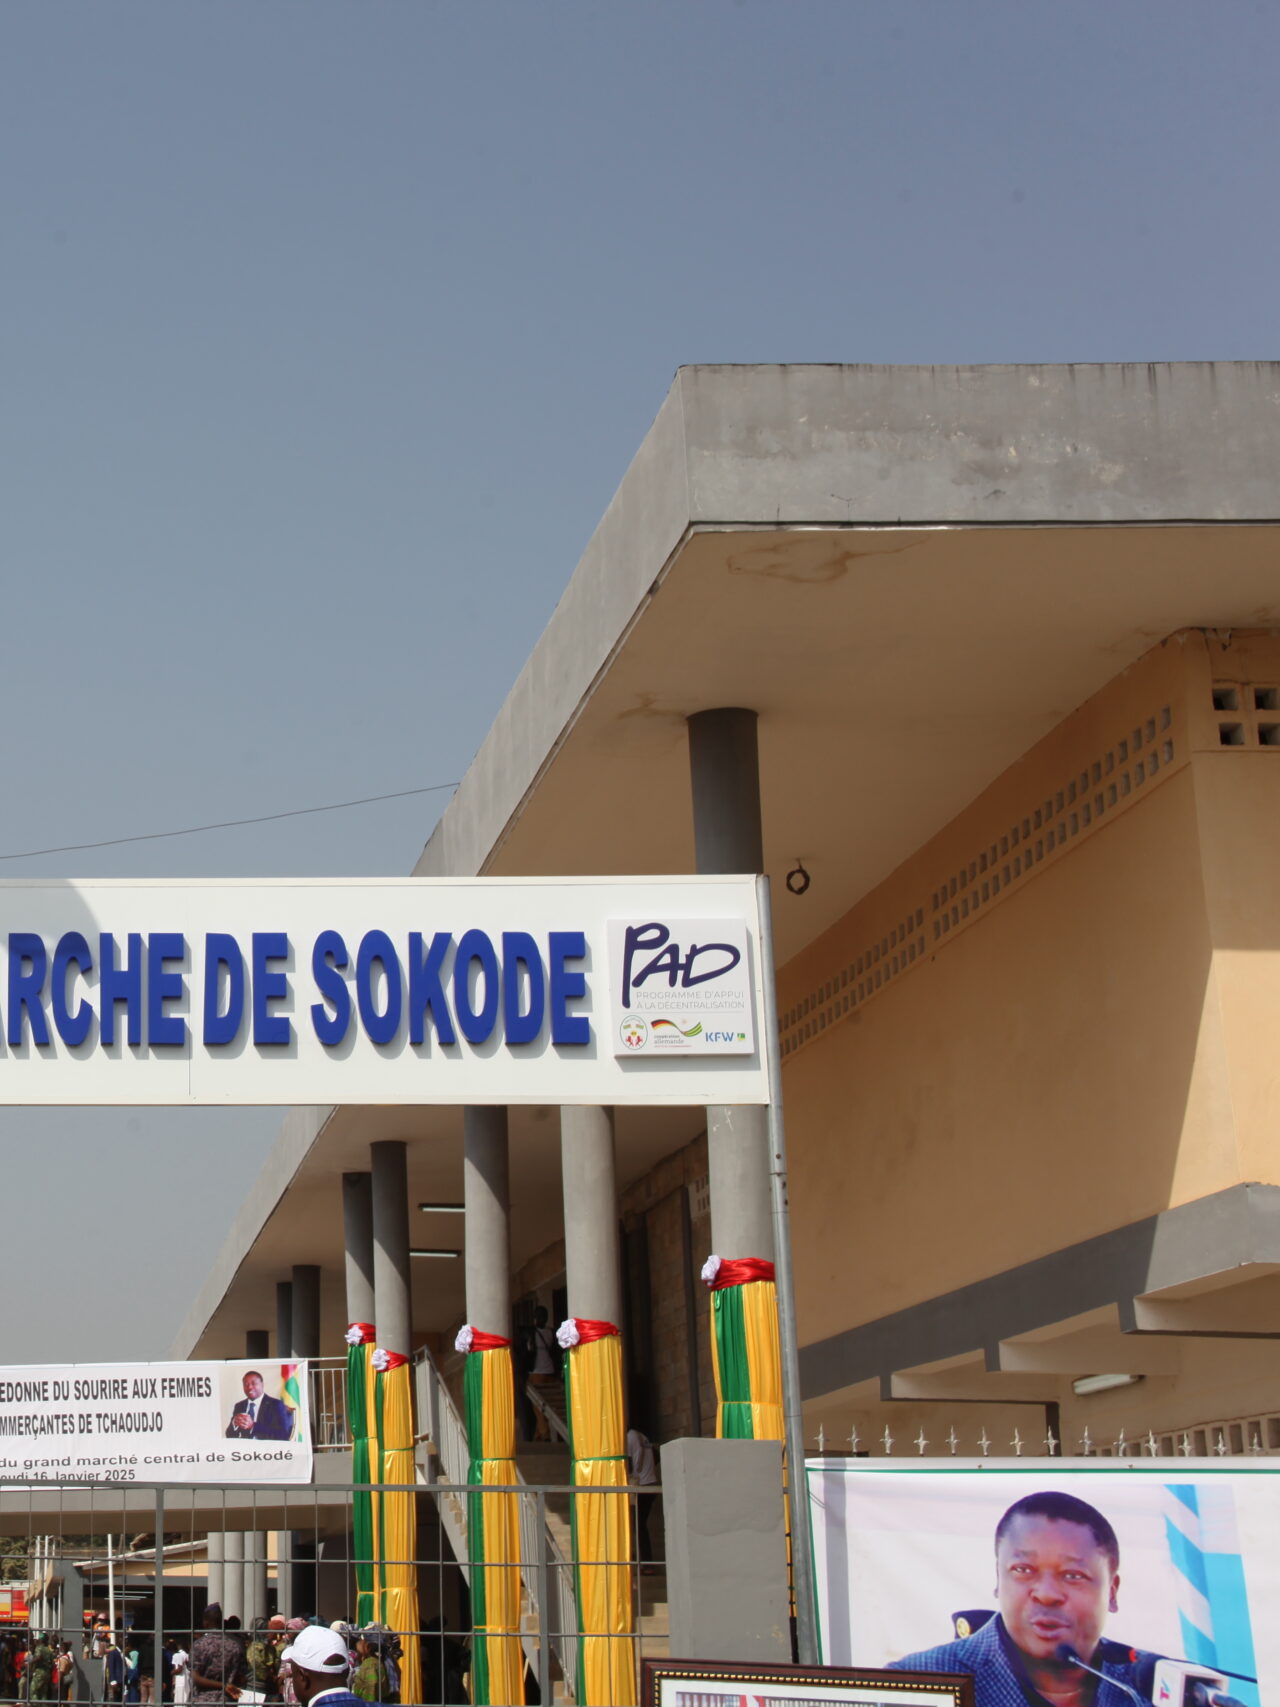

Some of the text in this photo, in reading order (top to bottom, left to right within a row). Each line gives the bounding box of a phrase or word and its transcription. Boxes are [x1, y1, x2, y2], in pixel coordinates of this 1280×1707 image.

[621, 922, 741, 1009] PAD
[203, 931, 293, 1045] DE
[310, 928, 593, 1046] SOKODE
[636, 990, 744, 999] PROGRAMME D'APPUI
[54, 1380, 70, 1401] DU
[74, 1379, 128, 1401] SOURIRE
[132, 1378, 158, 1400] AUX
[161, 1376, 212, 1399] FEMMES
[78, 1413, 93, 1434] DE
[96, 1411, 163, 1434] TCHAOUDJO
[23, 1456, 71, 1470] grand
[76, 1454, 138, 1466] marché
[144, 1453, 200, 1465] central
[206, 1452, 225, 1463] de
[231, 1450, 294, 1462] Sokodé
[105, 1469, 136, 1481] 2025
